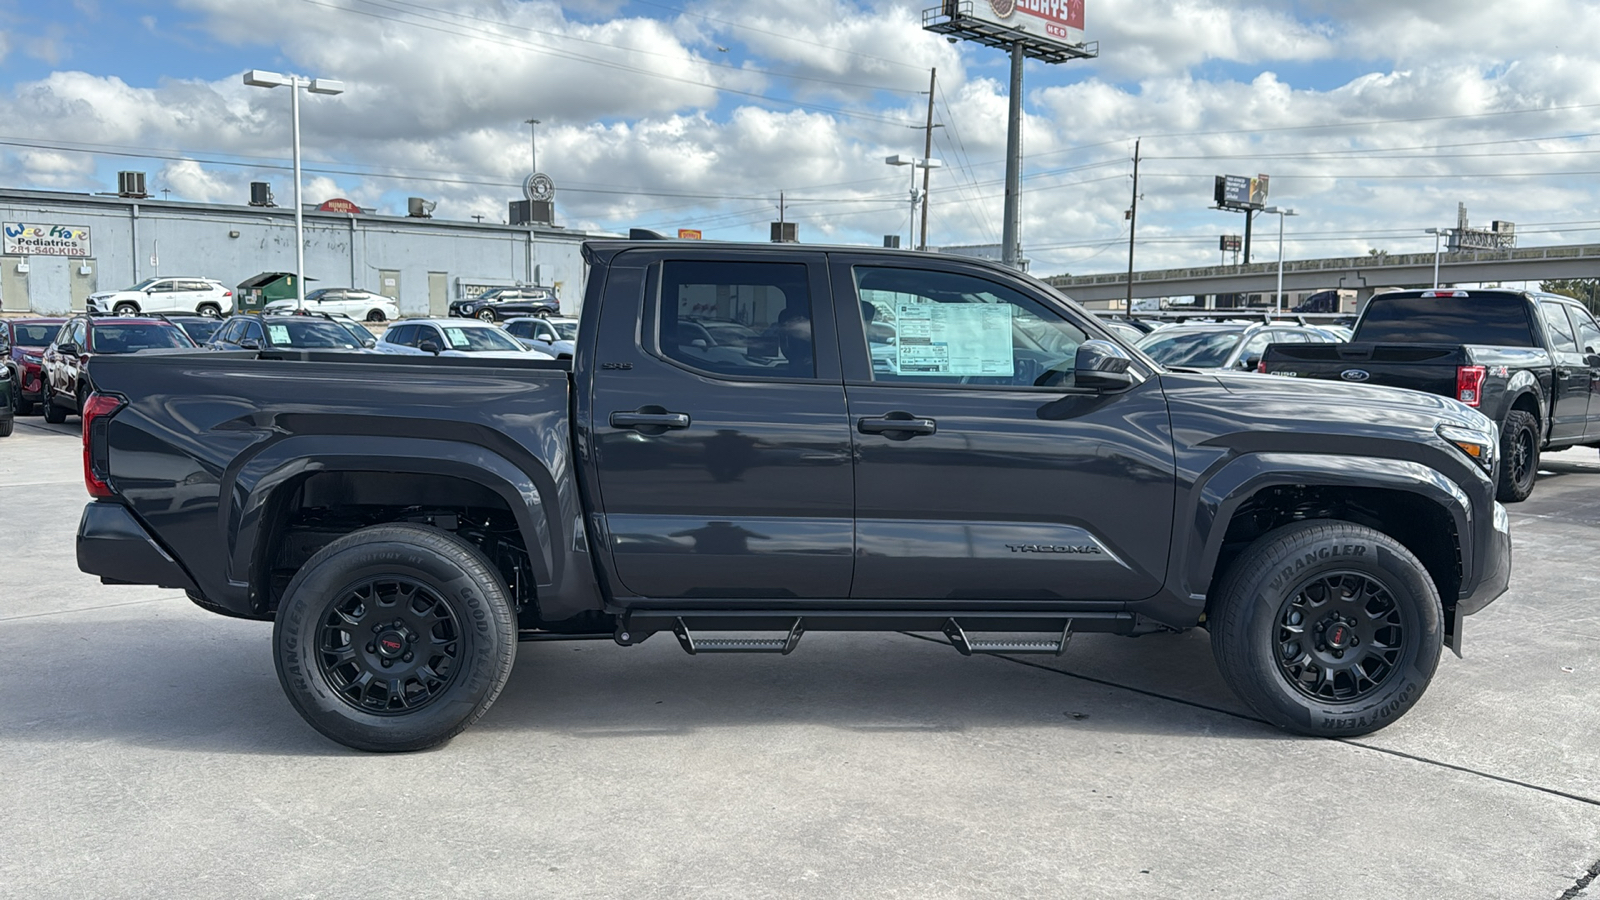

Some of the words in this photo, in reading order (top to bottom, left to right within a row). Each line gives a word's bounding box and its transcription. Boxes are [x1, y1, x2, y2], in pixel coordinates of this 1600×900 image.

[5, 223, 45, 238] Wee
[49, 225, 88, 241] Kare
[17, 238, 78, 247] Pediatrics
[10, 246, 86, 255] 281-540-KIDS
[1005, 544, 1102, 554] TACOMA
[1269, 545, 1367, 593] WRANGLER
[382, 639, 401, 648] TRD
[1321, 683, 1417, 730] GOODYEAR
